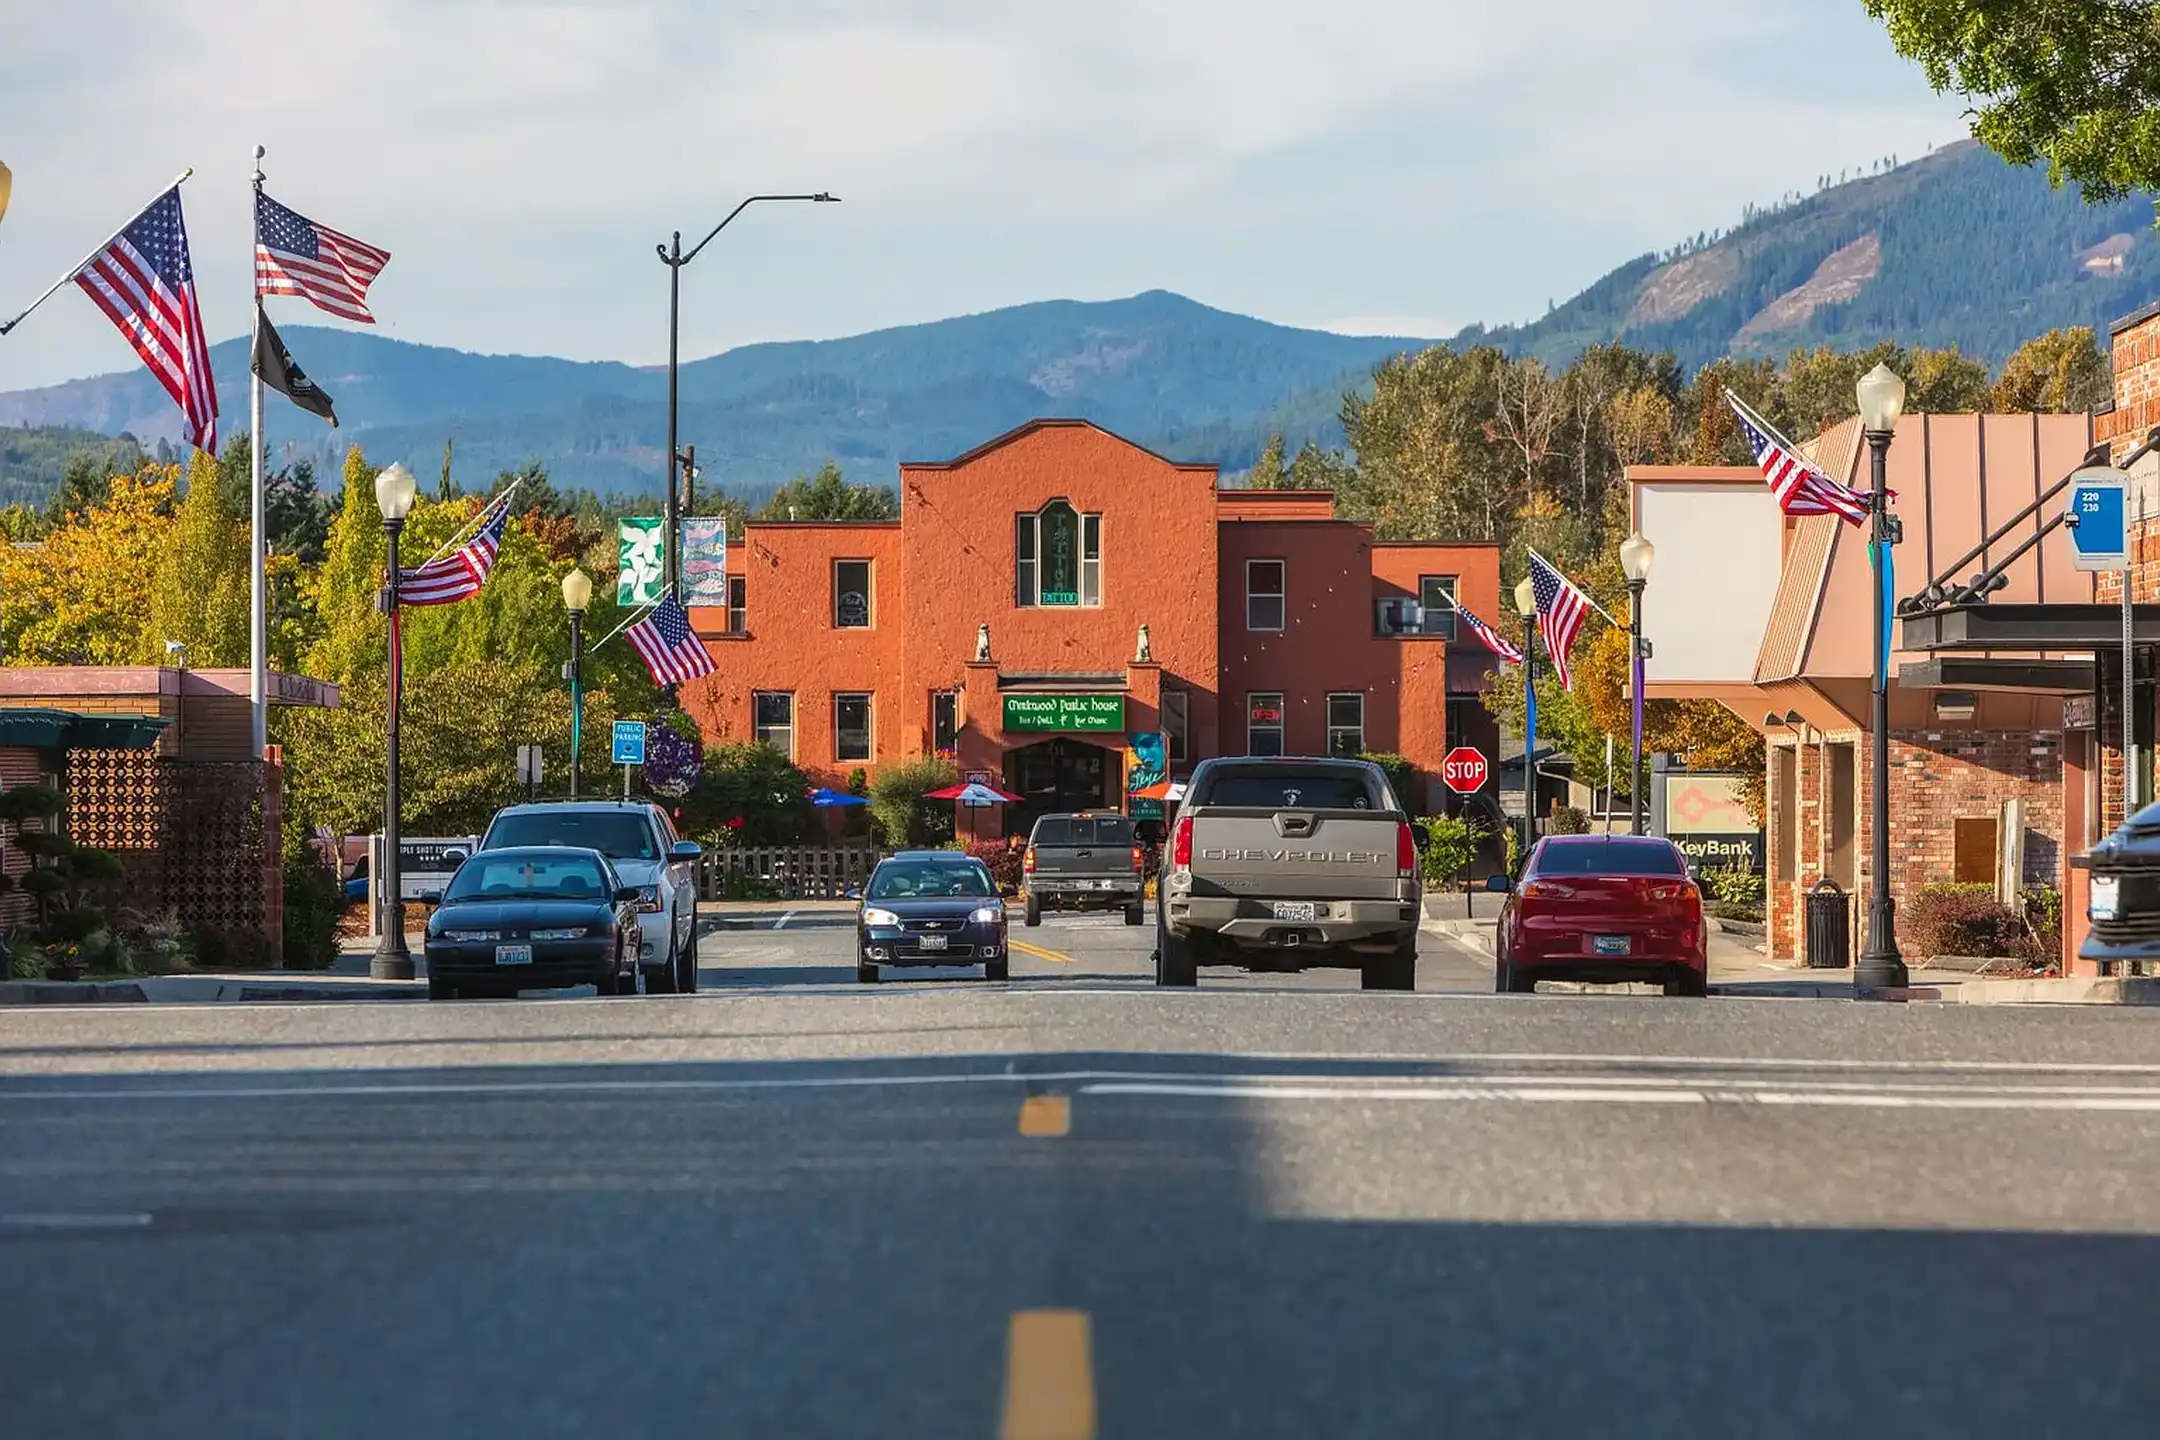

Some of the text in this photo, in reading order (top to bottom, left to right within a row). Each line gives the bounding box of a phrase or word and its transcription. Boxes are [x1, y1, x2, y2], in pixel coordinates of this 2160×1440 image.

[2082, 492, 2099, 501] 220
[2083, 503, 2099, 512] 230
[1042, 592, 1078, 604] TATTOO
[617, 724, 641, 732] PUBLIC
[1446, 761, 1484, 779] STOP
[1674, 840, 1753, 857] KeyBank
[1202, 849, 1388, 863] CHEVROLET
